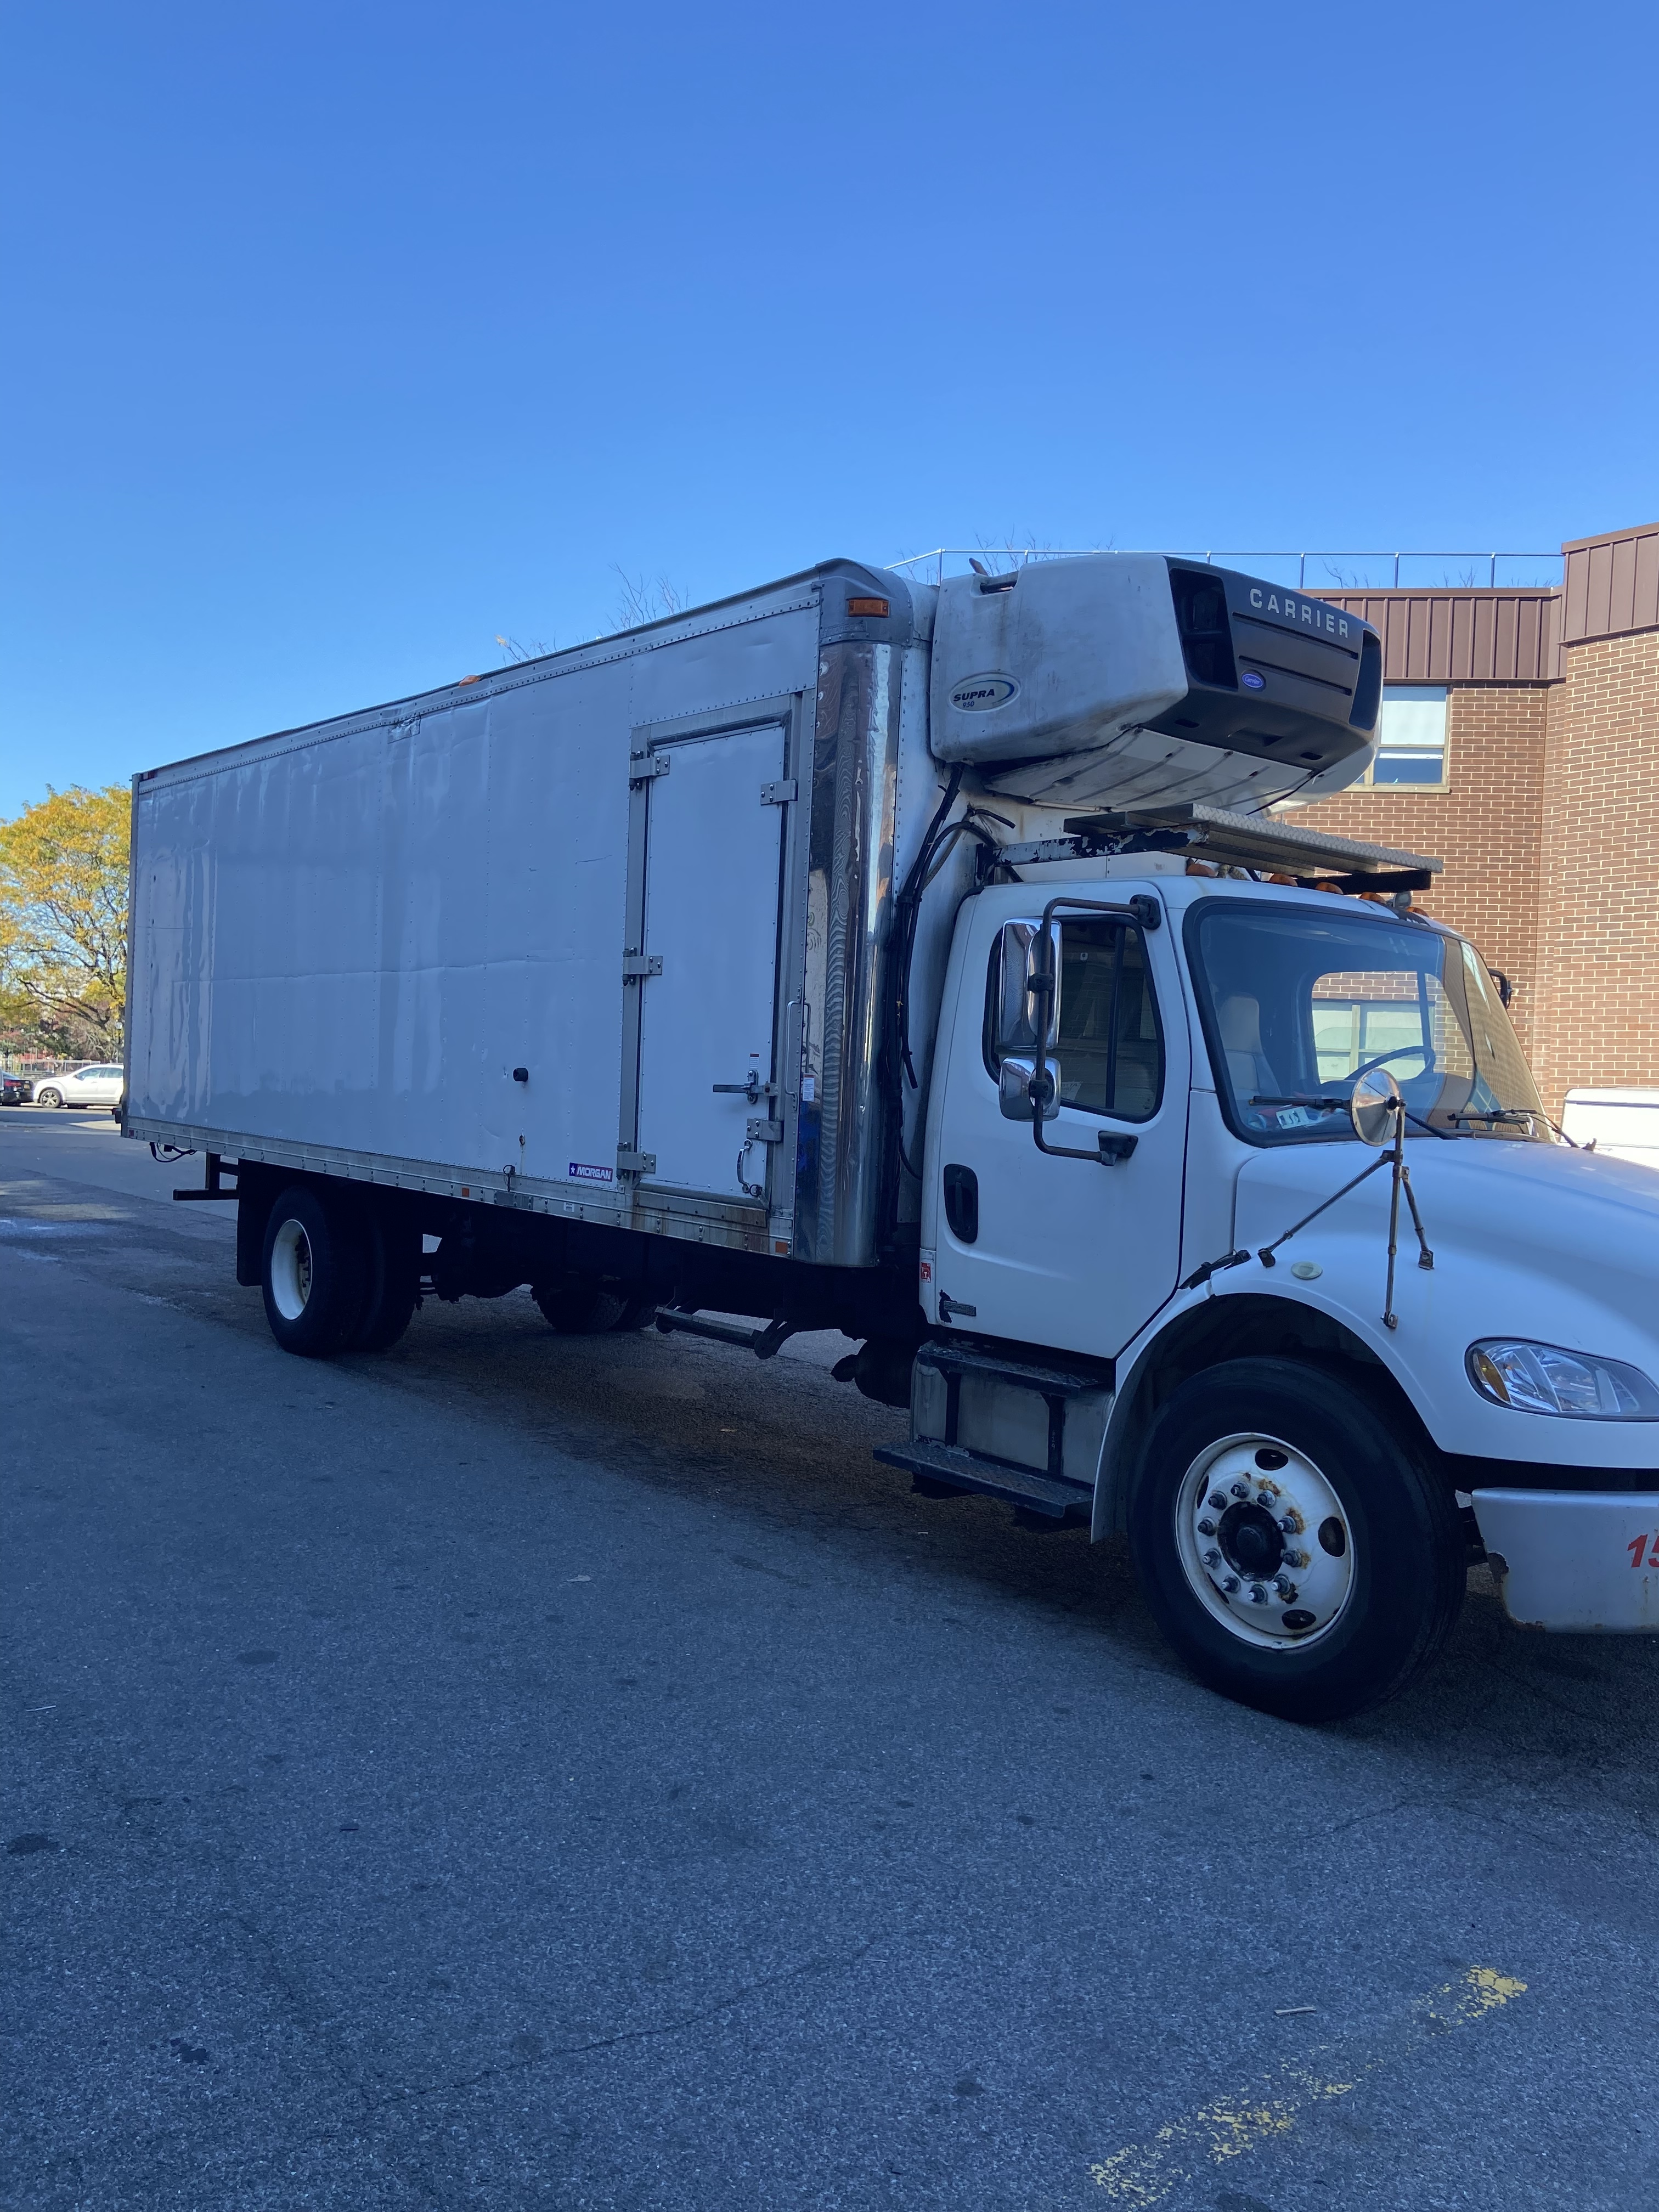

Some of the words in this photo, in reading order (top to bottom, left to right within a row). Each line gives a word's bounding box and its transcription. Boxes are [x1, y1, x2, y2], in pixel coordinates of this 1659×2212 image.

[1250, 588, 1348, 639] CARRIER
[953, 689, 995, 702] SUPRA
[577, 1166, 612, 1180] MORGAN
